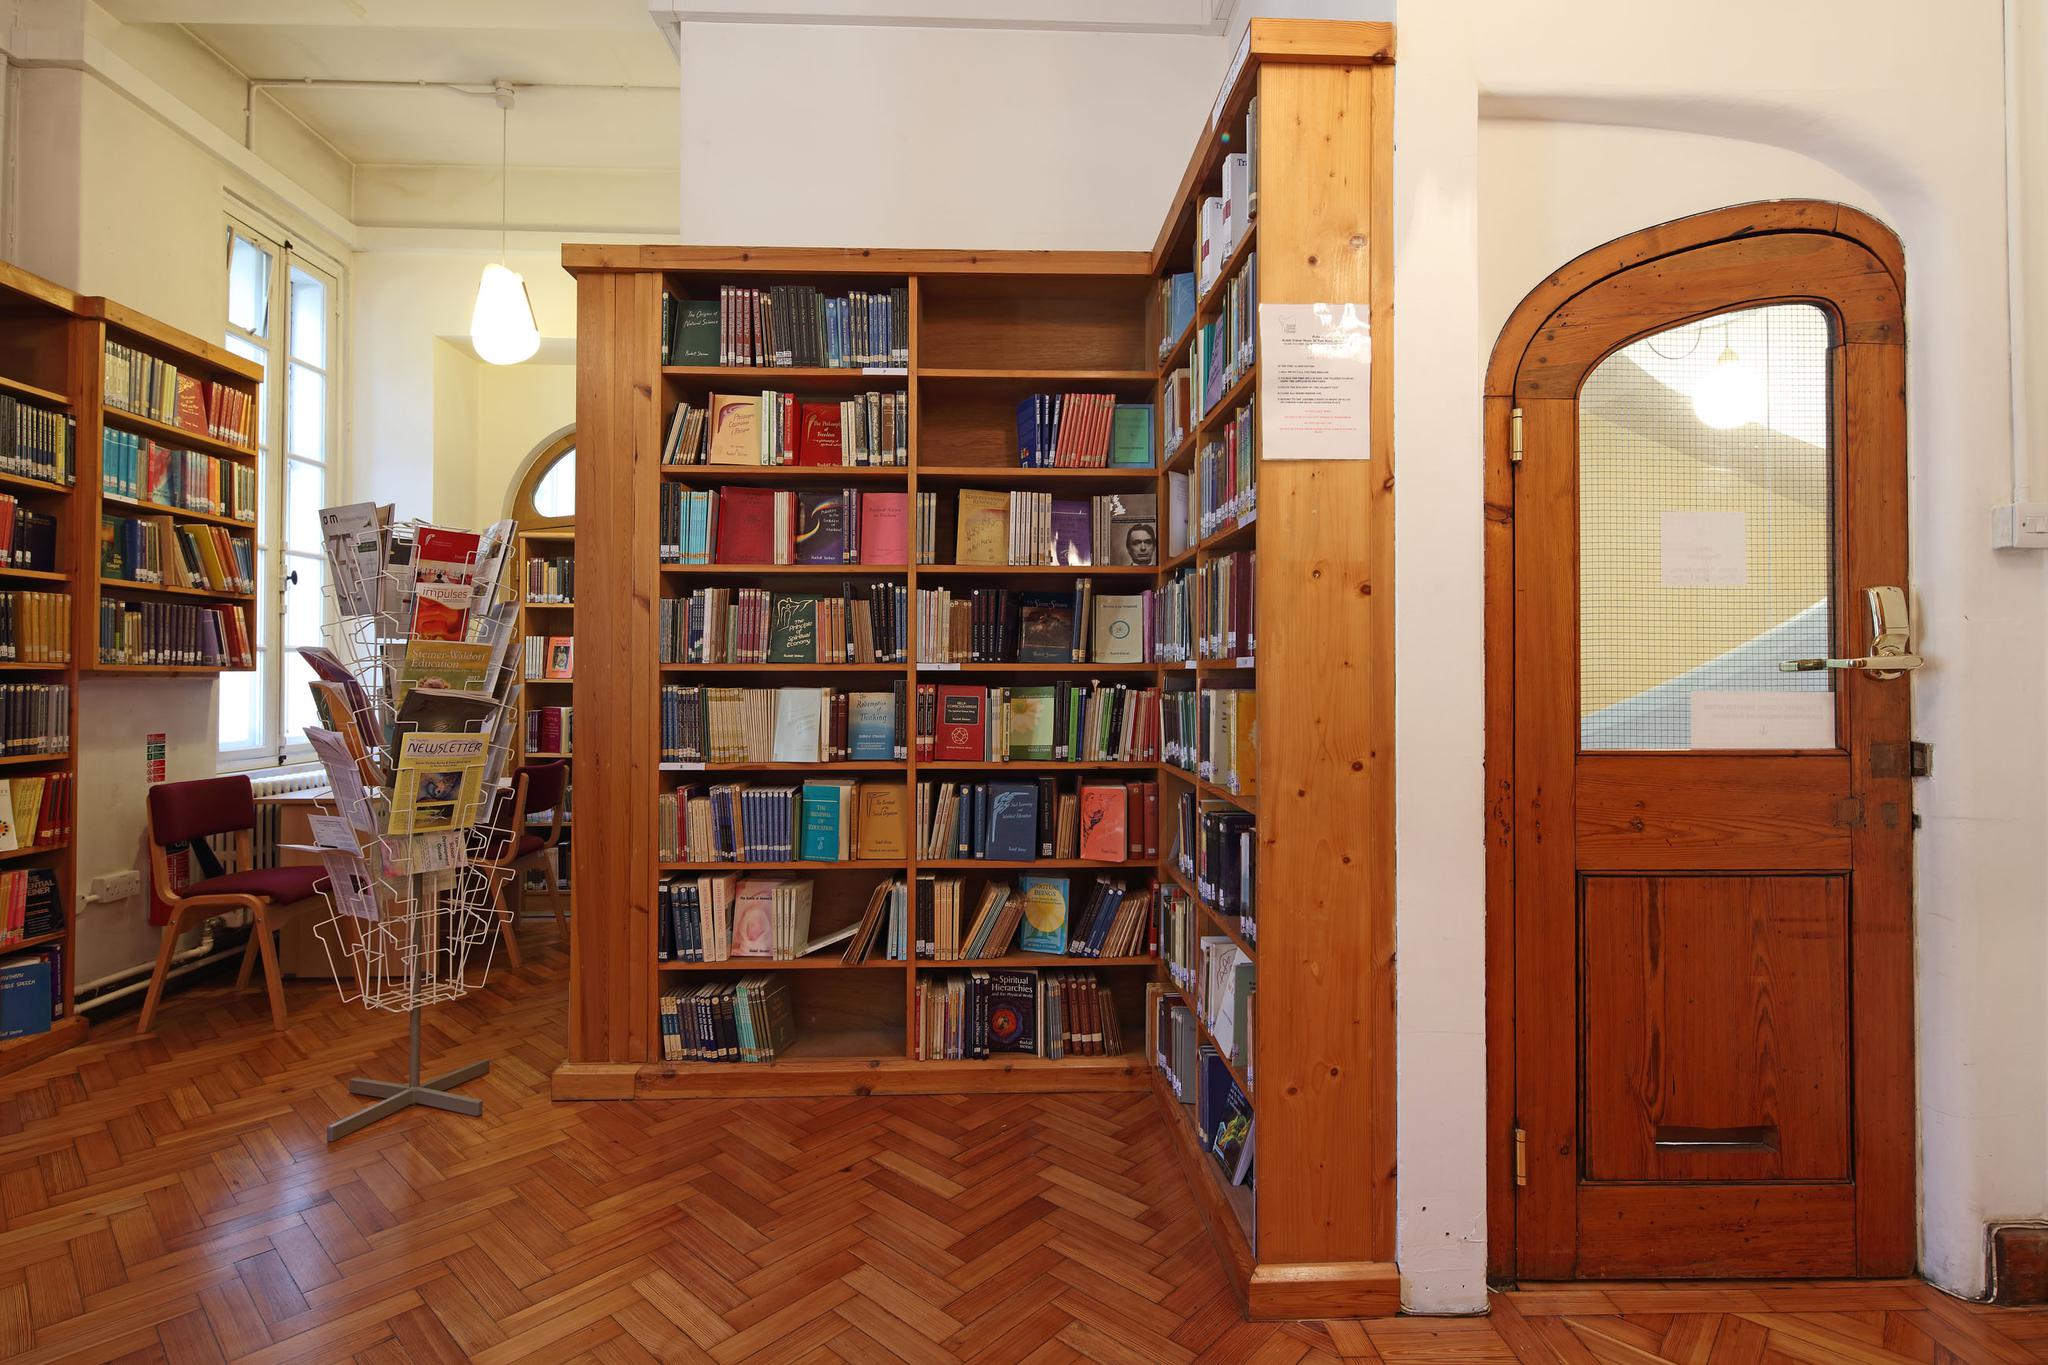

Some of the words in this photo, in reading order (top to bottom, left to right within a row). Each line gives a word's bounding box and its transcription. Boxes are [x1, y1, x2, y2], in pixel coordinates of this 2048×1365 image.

[423, 587, 468, 600] impulses
[412, 647, 487, 661] Steiner-Waldorf
[411, 658, 459, 669] Education
[407, 742, 483, 755] NEWSLETTER
[999, 975, 1029, 985] Spiritual
[991, 983, 1033, 993] Hierarchies
